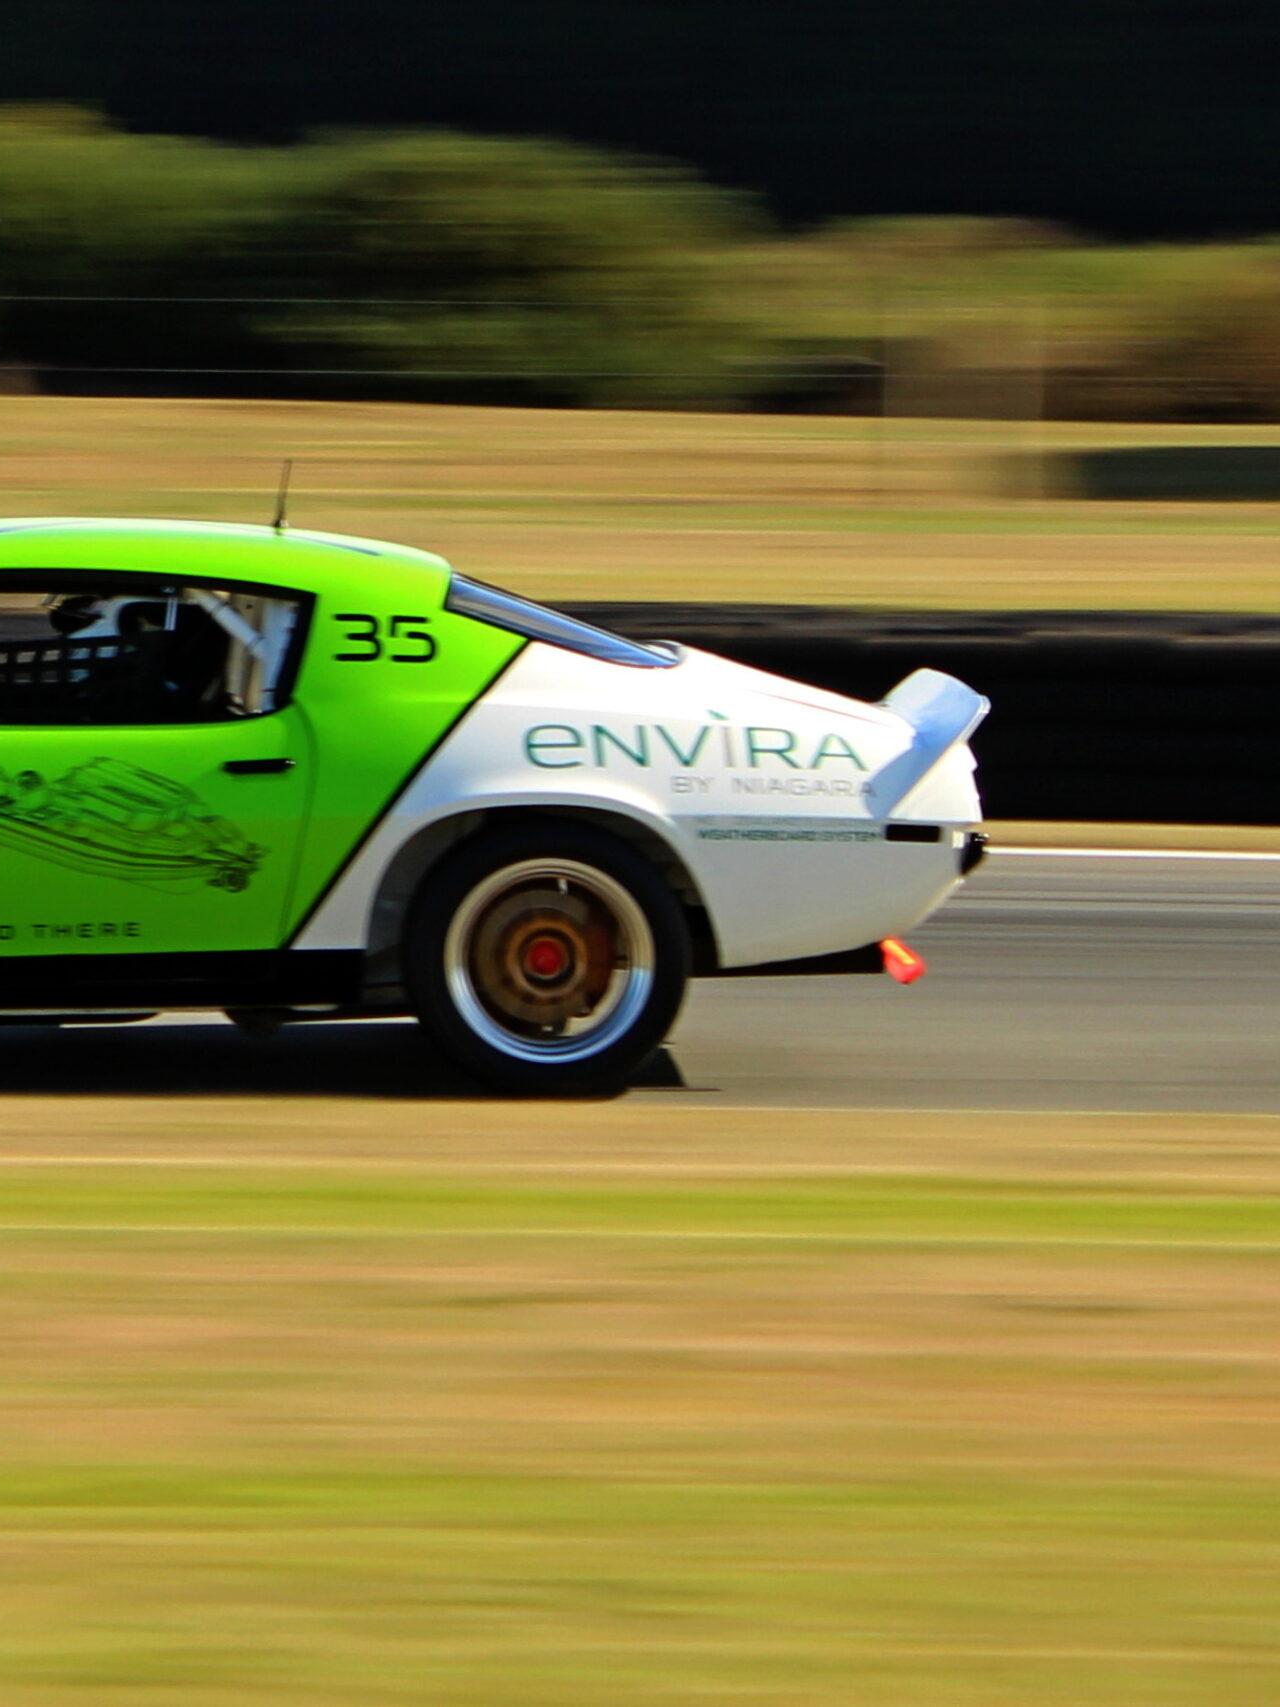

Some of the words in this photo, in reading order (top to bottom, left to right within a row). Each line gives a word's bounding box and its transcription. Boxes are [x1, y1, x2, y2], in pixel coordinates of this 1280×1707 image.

[333, 612, 435, 663] 35
[672, 776, 714, 794] BY
[731, 777, 877, 798] NIAGARA
[32, 922, 141, 939] THERE
